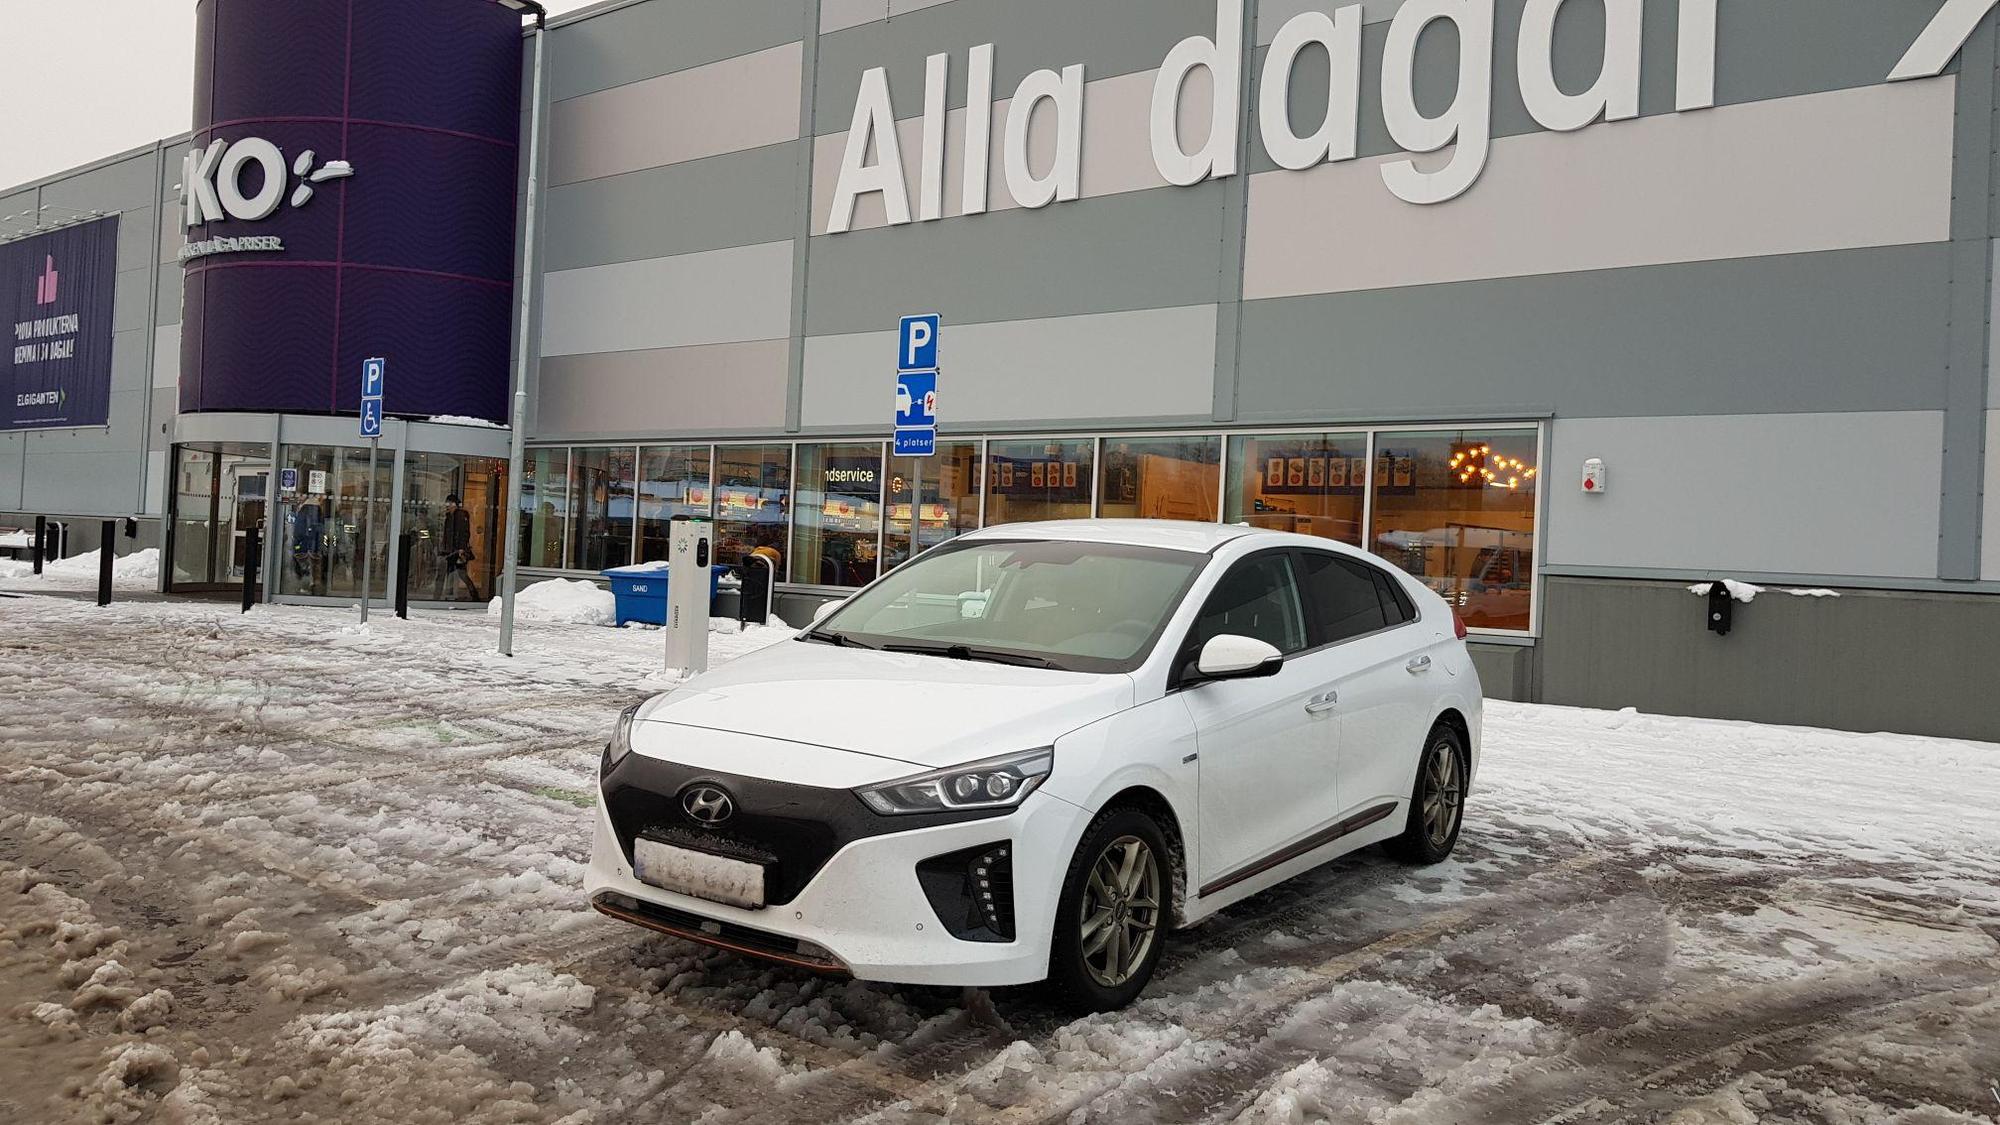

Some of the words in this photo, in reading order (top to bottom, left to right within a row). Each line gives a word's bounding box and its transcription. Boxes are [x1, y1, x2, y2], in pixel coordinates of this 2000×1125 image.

[826, 43, 1085, 234] Alla
[908, 321, 932, 365] P
[367, 363, 380, 394] P
[17, 390, 59, 407] ELGIGANTEN
[895, 438, 901, 446] 4
[903, 437, 933, 448] platser
[632, 584, 648, 593] SAND
